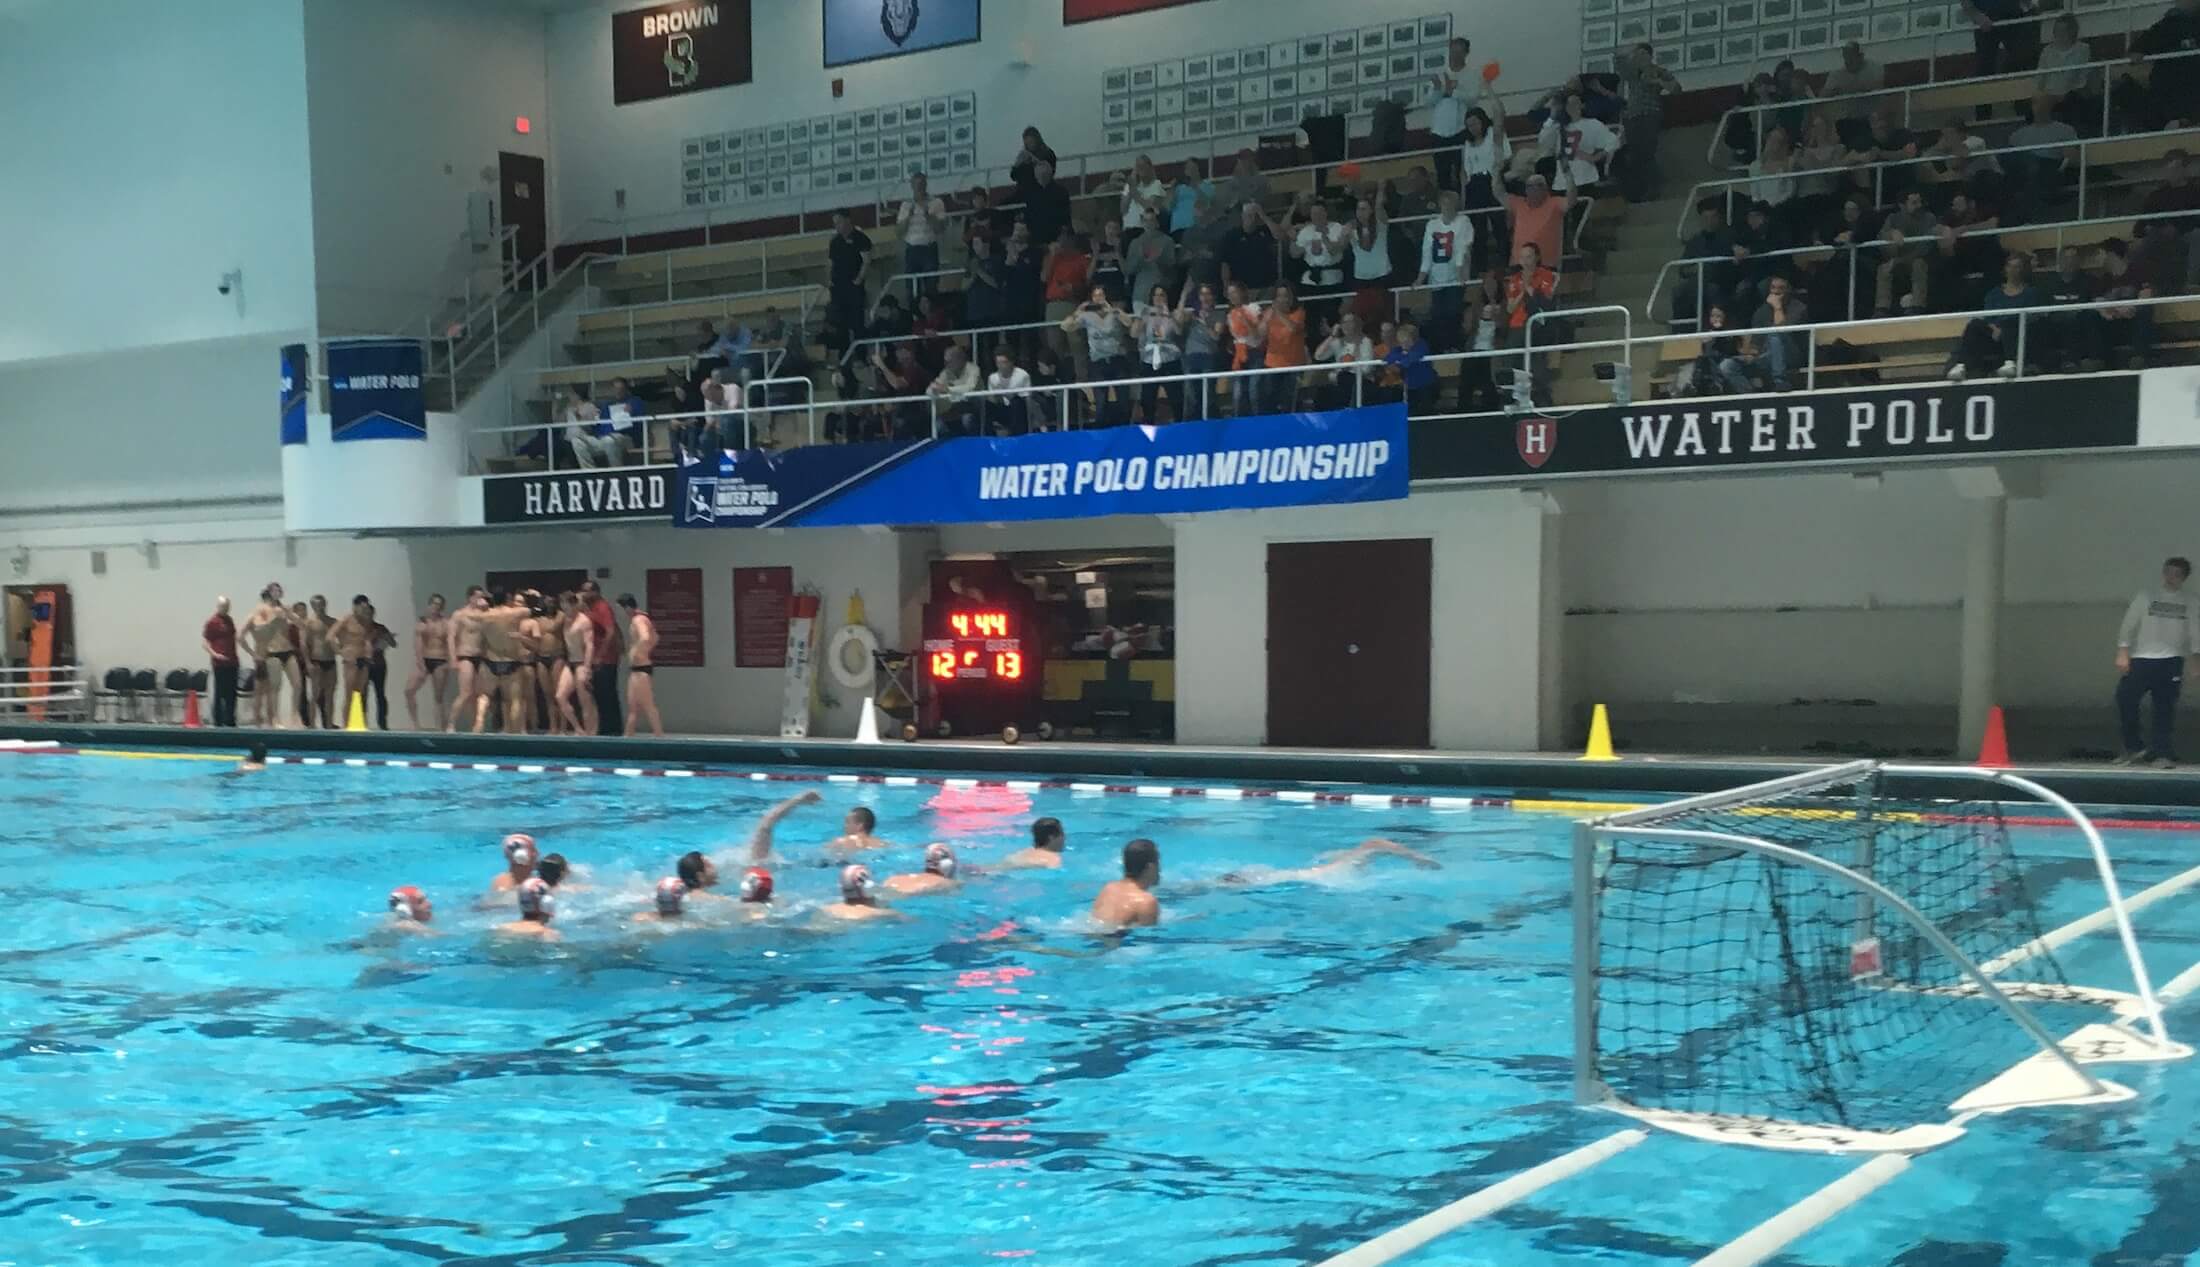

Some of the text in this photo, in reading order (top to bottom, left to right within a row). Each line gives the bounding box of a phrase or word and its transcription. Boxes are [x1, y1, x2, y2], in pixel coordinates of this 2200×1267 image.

[643, 4, 719, 38] BROWN
[349, 375, 388, 390] WATER
[390, 375, 419, 389] POLO
[1525, 424, 1547, 454] H
[1622, 396, 1995, 459] WATER POLO
[979, 440, 1389, 500] WATER POLO CHAMPIONSHIP
[524, 476, 665, 515] HARVARD
[932, 652, 956, 678] 12
[996, 651, 1021, 678] 13
